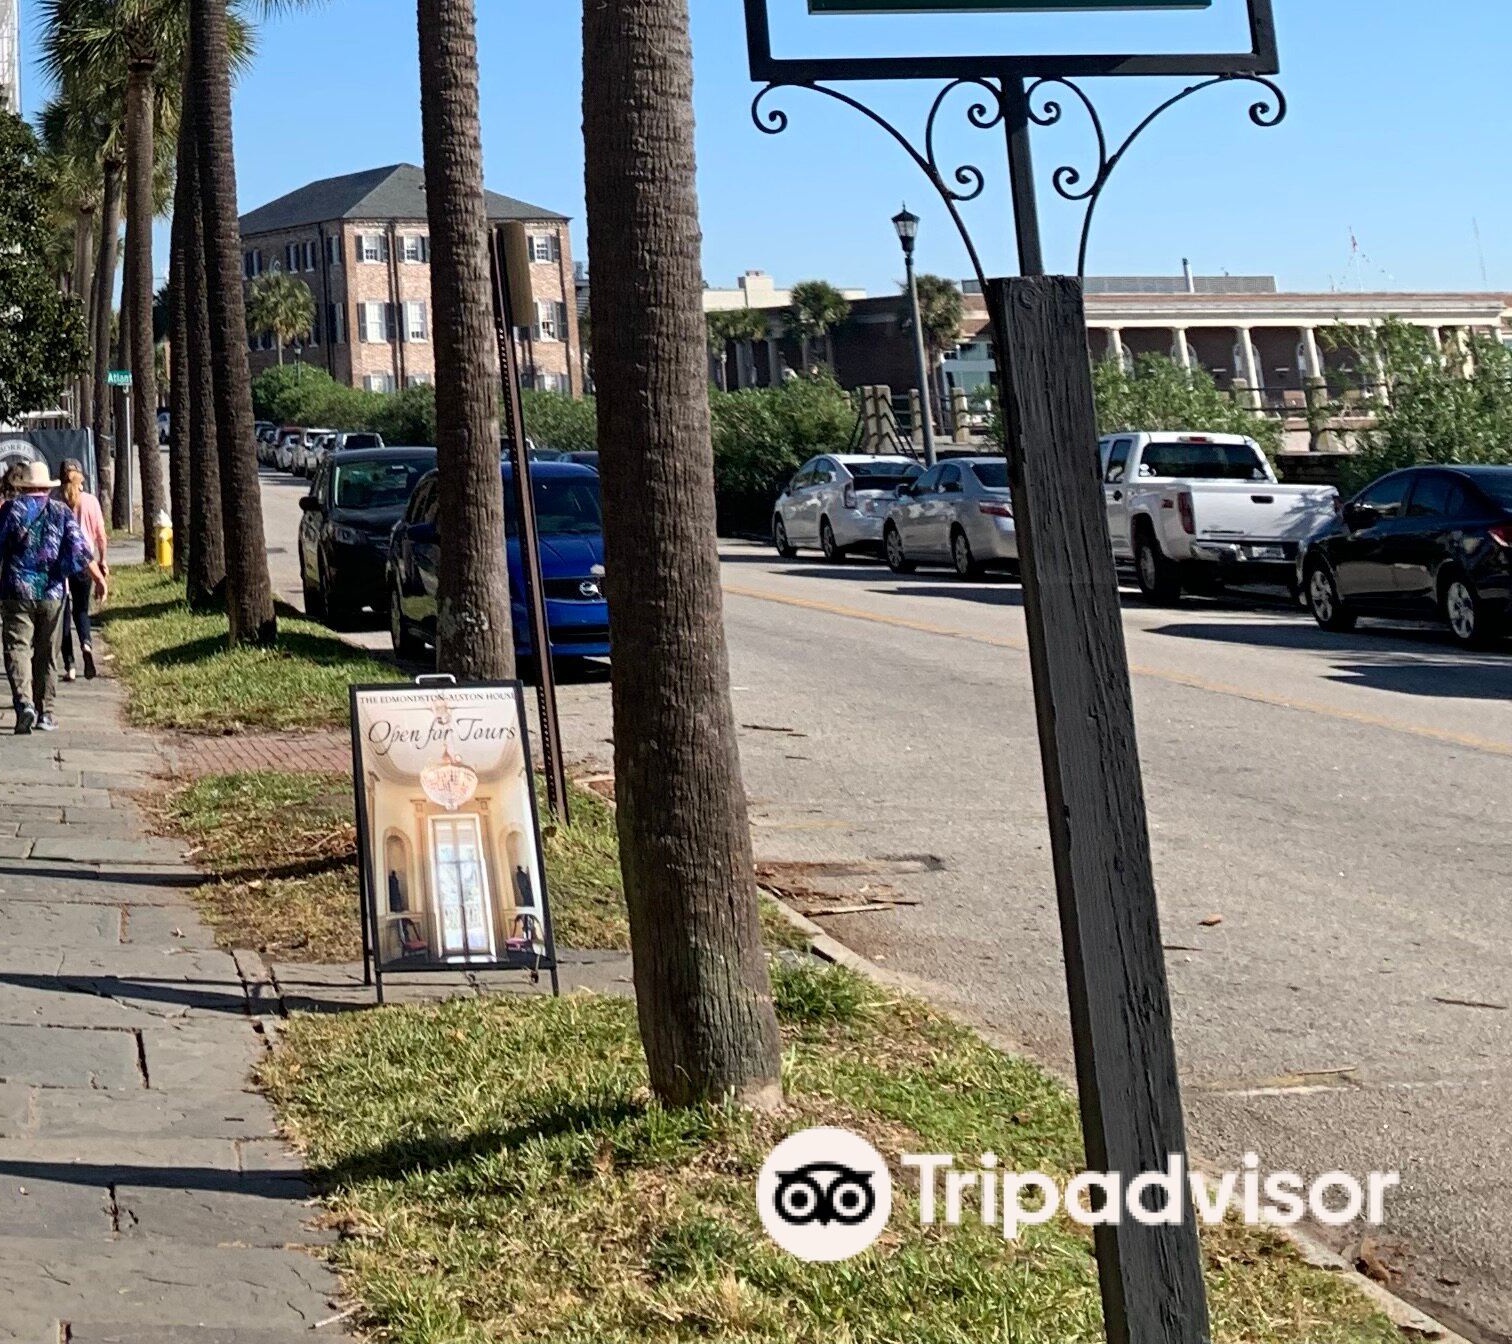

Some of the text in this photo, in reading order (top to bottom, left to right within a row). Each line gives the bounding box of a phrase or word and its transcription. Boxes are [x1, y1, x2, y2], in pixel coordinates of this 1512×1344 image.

[359, 696, 378, 705] THE
[368, 716, 516, 756] Open for Tours
